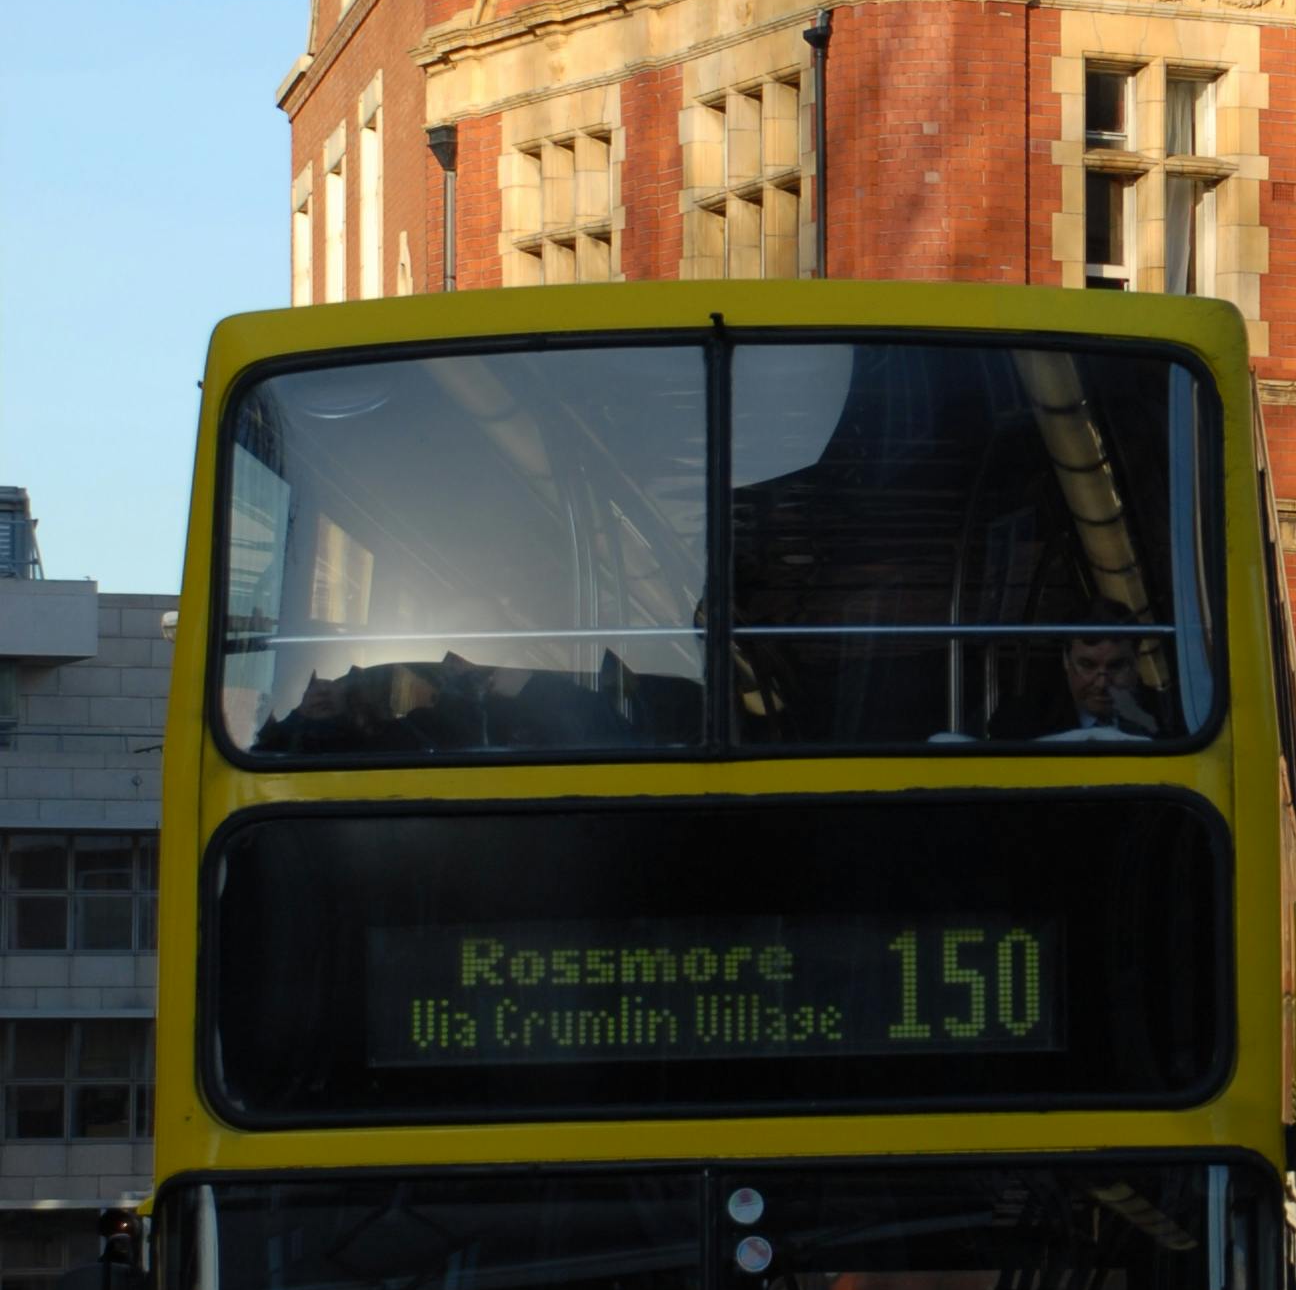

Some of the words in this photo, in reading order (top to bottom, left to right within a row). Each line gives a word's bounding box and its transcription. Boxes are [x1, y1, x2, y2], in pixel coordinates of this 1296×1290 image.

[462, 939, 794, 986] Rossmore
[889, 928, 1040, 1038] 150
[412, 998, 477, 1047] Via
[496, 995, 678, 1046] Crumlin
[697, 994, 843, 1042] Village
